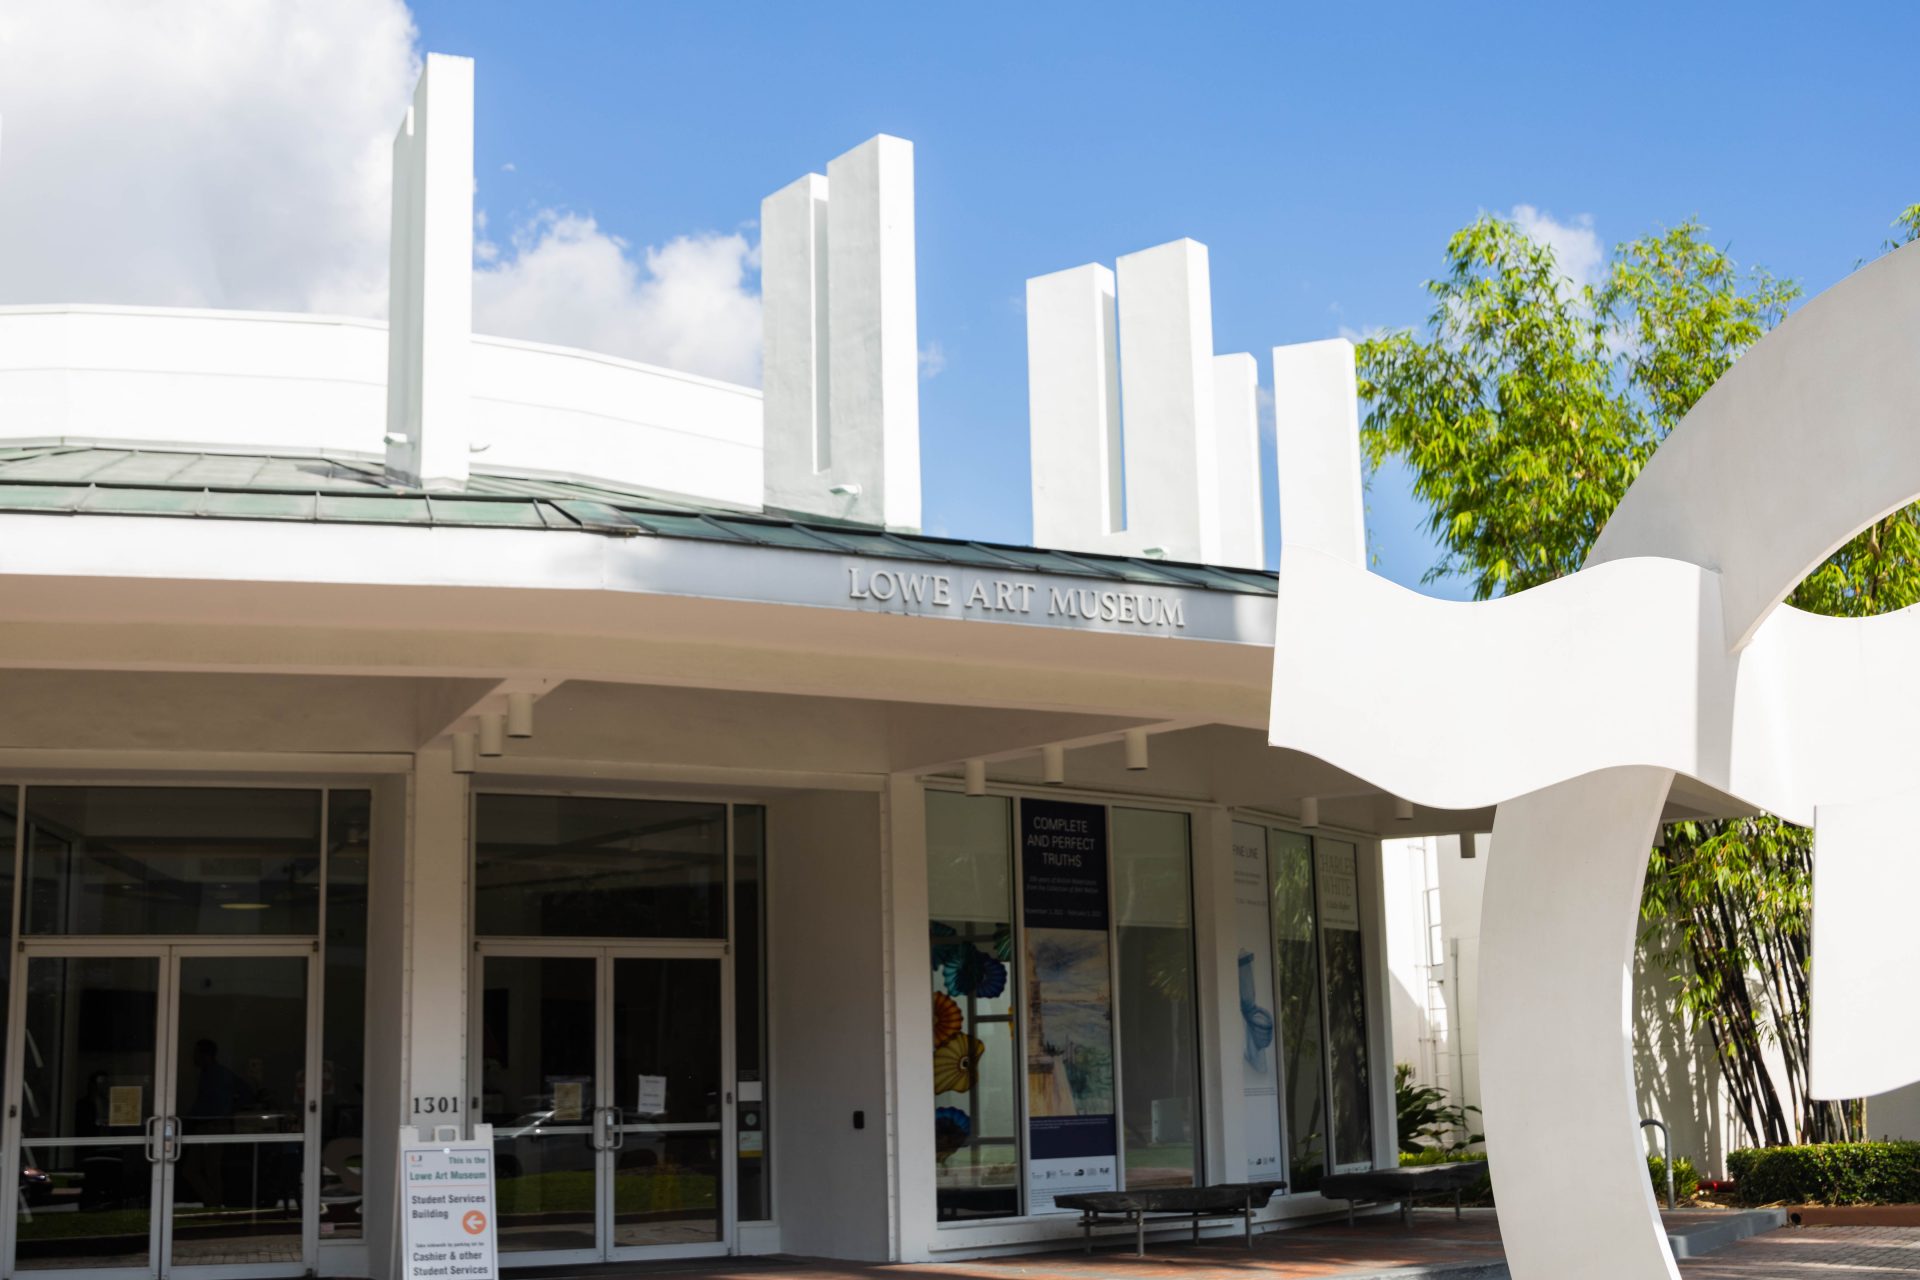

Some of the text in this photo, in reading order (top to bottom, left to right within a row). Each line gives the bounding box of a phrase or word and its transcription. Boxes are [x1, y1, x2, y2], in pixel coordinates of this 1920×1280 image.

[849, 567, 1185, 628] LOWE ART MUSEUM
[1033, 816, 1088, 833] COMPLETE
[1027, 834, 1095, 850] AND PERFECT
[1042, 852, 1082, 868] TRUTHS
[413, 1096, 458, 1114] 1301
[448, 1155, 486, 1164] This is the
[410, 1170, 486, 1180] Lowe Art Museum
[411, 1194, 486, 1204] Student Services
[412, 1209, 449, 1220] Building
[413, 1250, 482, 1261] Cashier & other
[413, 1265, 488, 1276] Student Services
